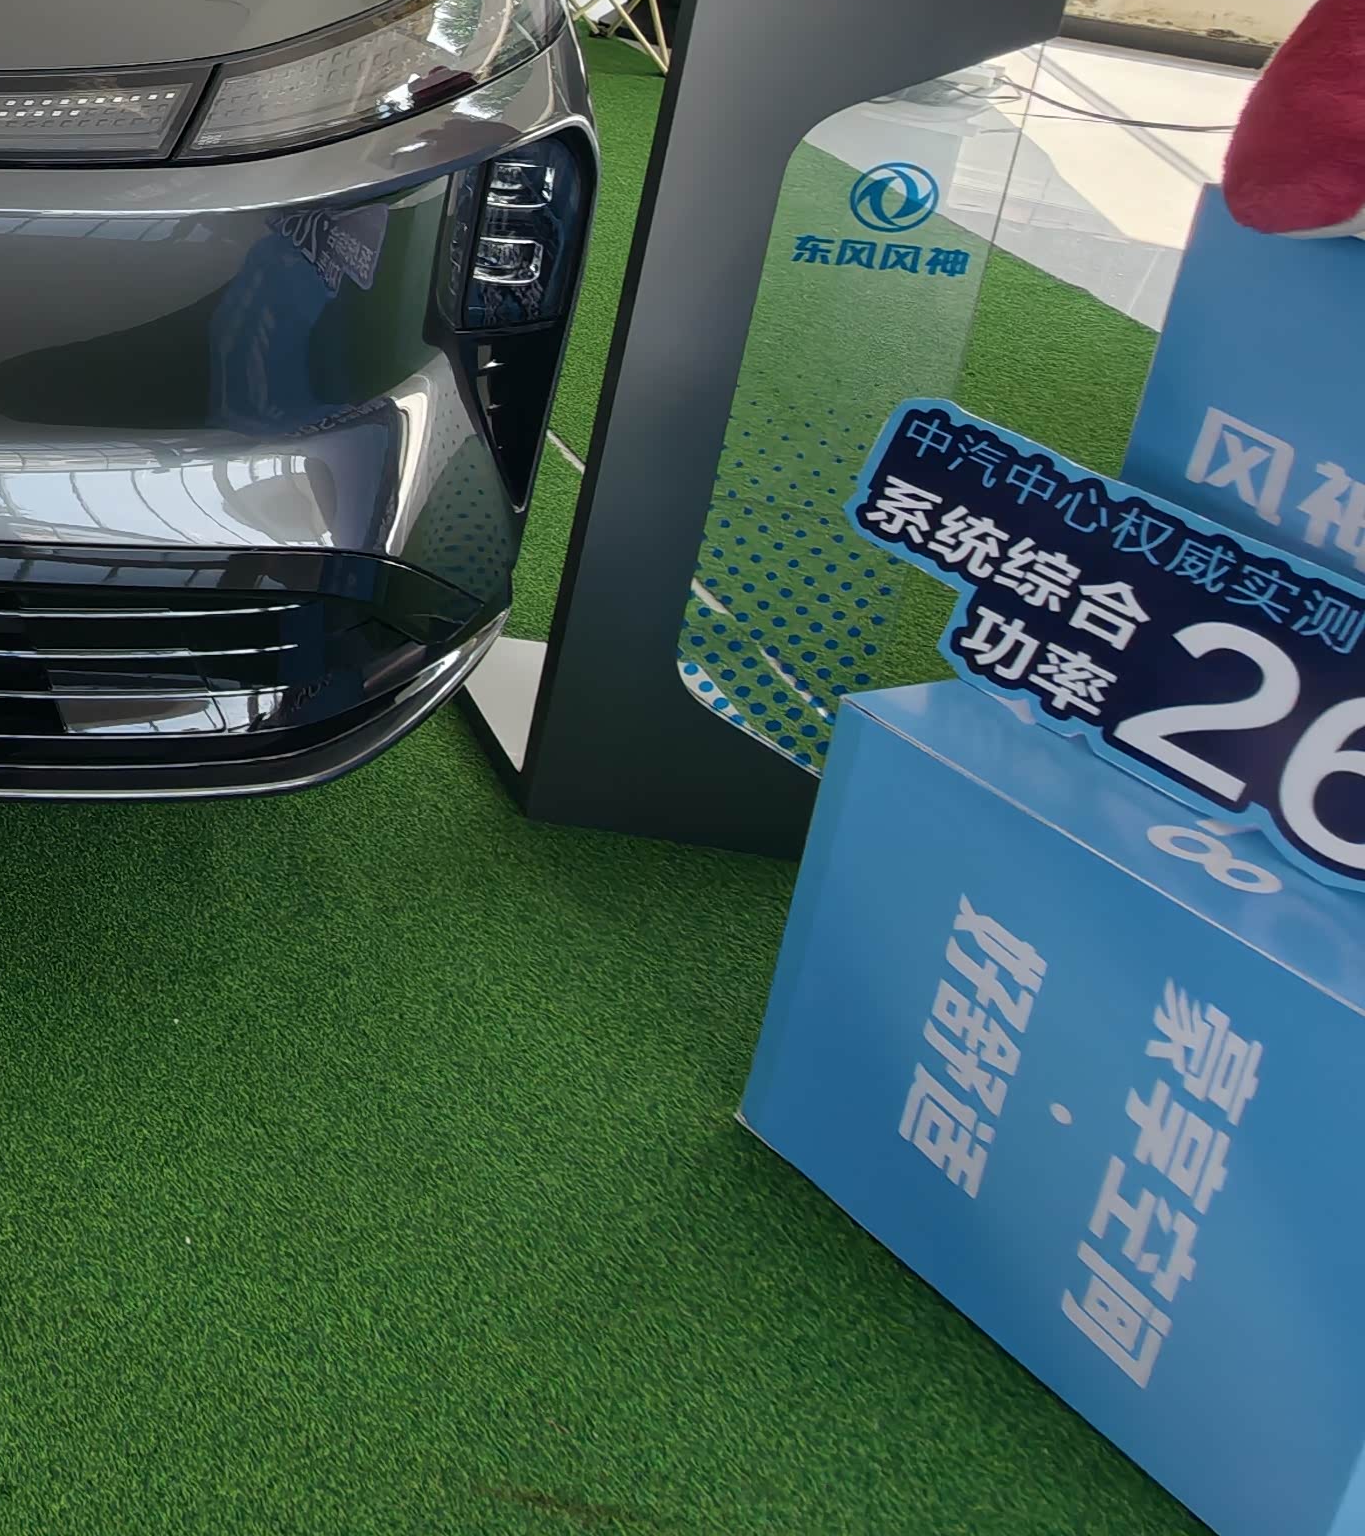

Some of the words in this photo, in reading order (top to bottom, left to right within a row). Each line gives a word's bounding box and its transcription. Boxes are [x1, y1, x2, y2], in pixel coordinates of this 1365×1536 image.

[791, 235, 971, 278] 东风风神
[866, 473, 1151, 651] 系统综合
[905, 417, 1365, 655] 中汽中心权威实测
[961, 604, 1119, 720] 功率
[898, 893, 1049, 1199] 好舒适
[1062, 976, 1263, 1389] 豪享空间
